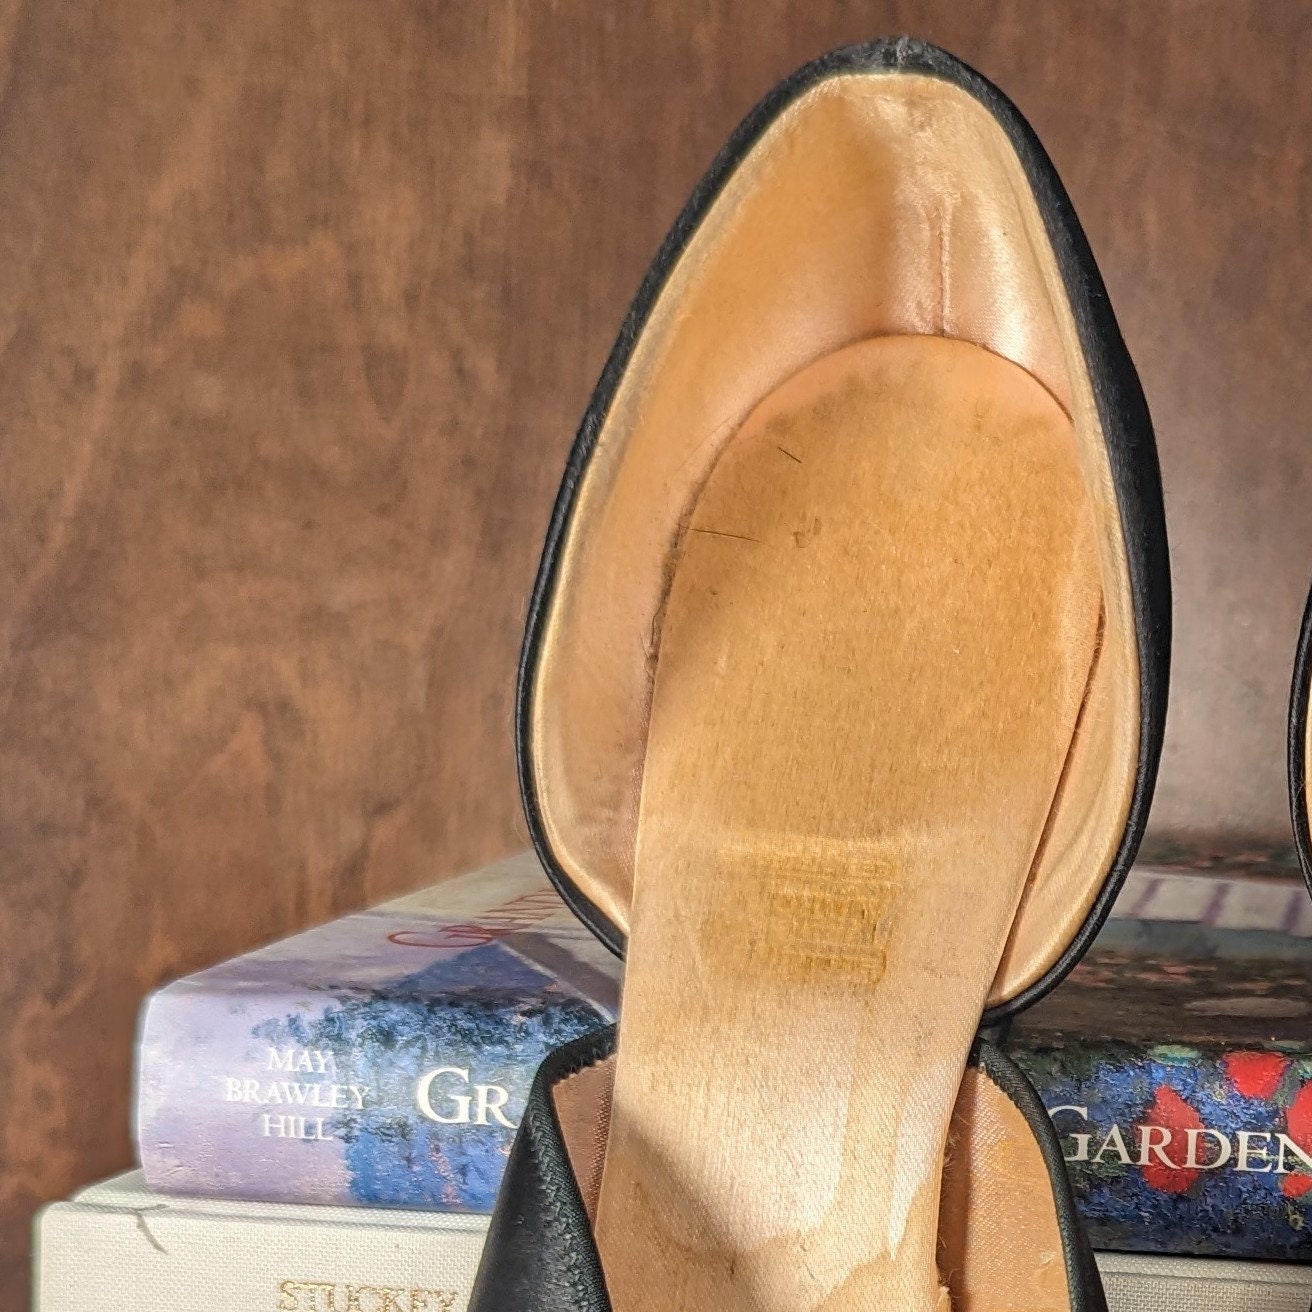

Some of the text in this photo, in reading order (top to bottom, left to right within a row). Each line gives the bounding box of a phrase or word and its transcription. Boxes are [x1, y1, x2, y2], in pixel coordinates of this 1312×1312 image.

[266, 1047, 334, 1074] MAY
[225, 1077, 371, 1110] BRAWLEY
[263, 1114, 333, 1141] HILL
